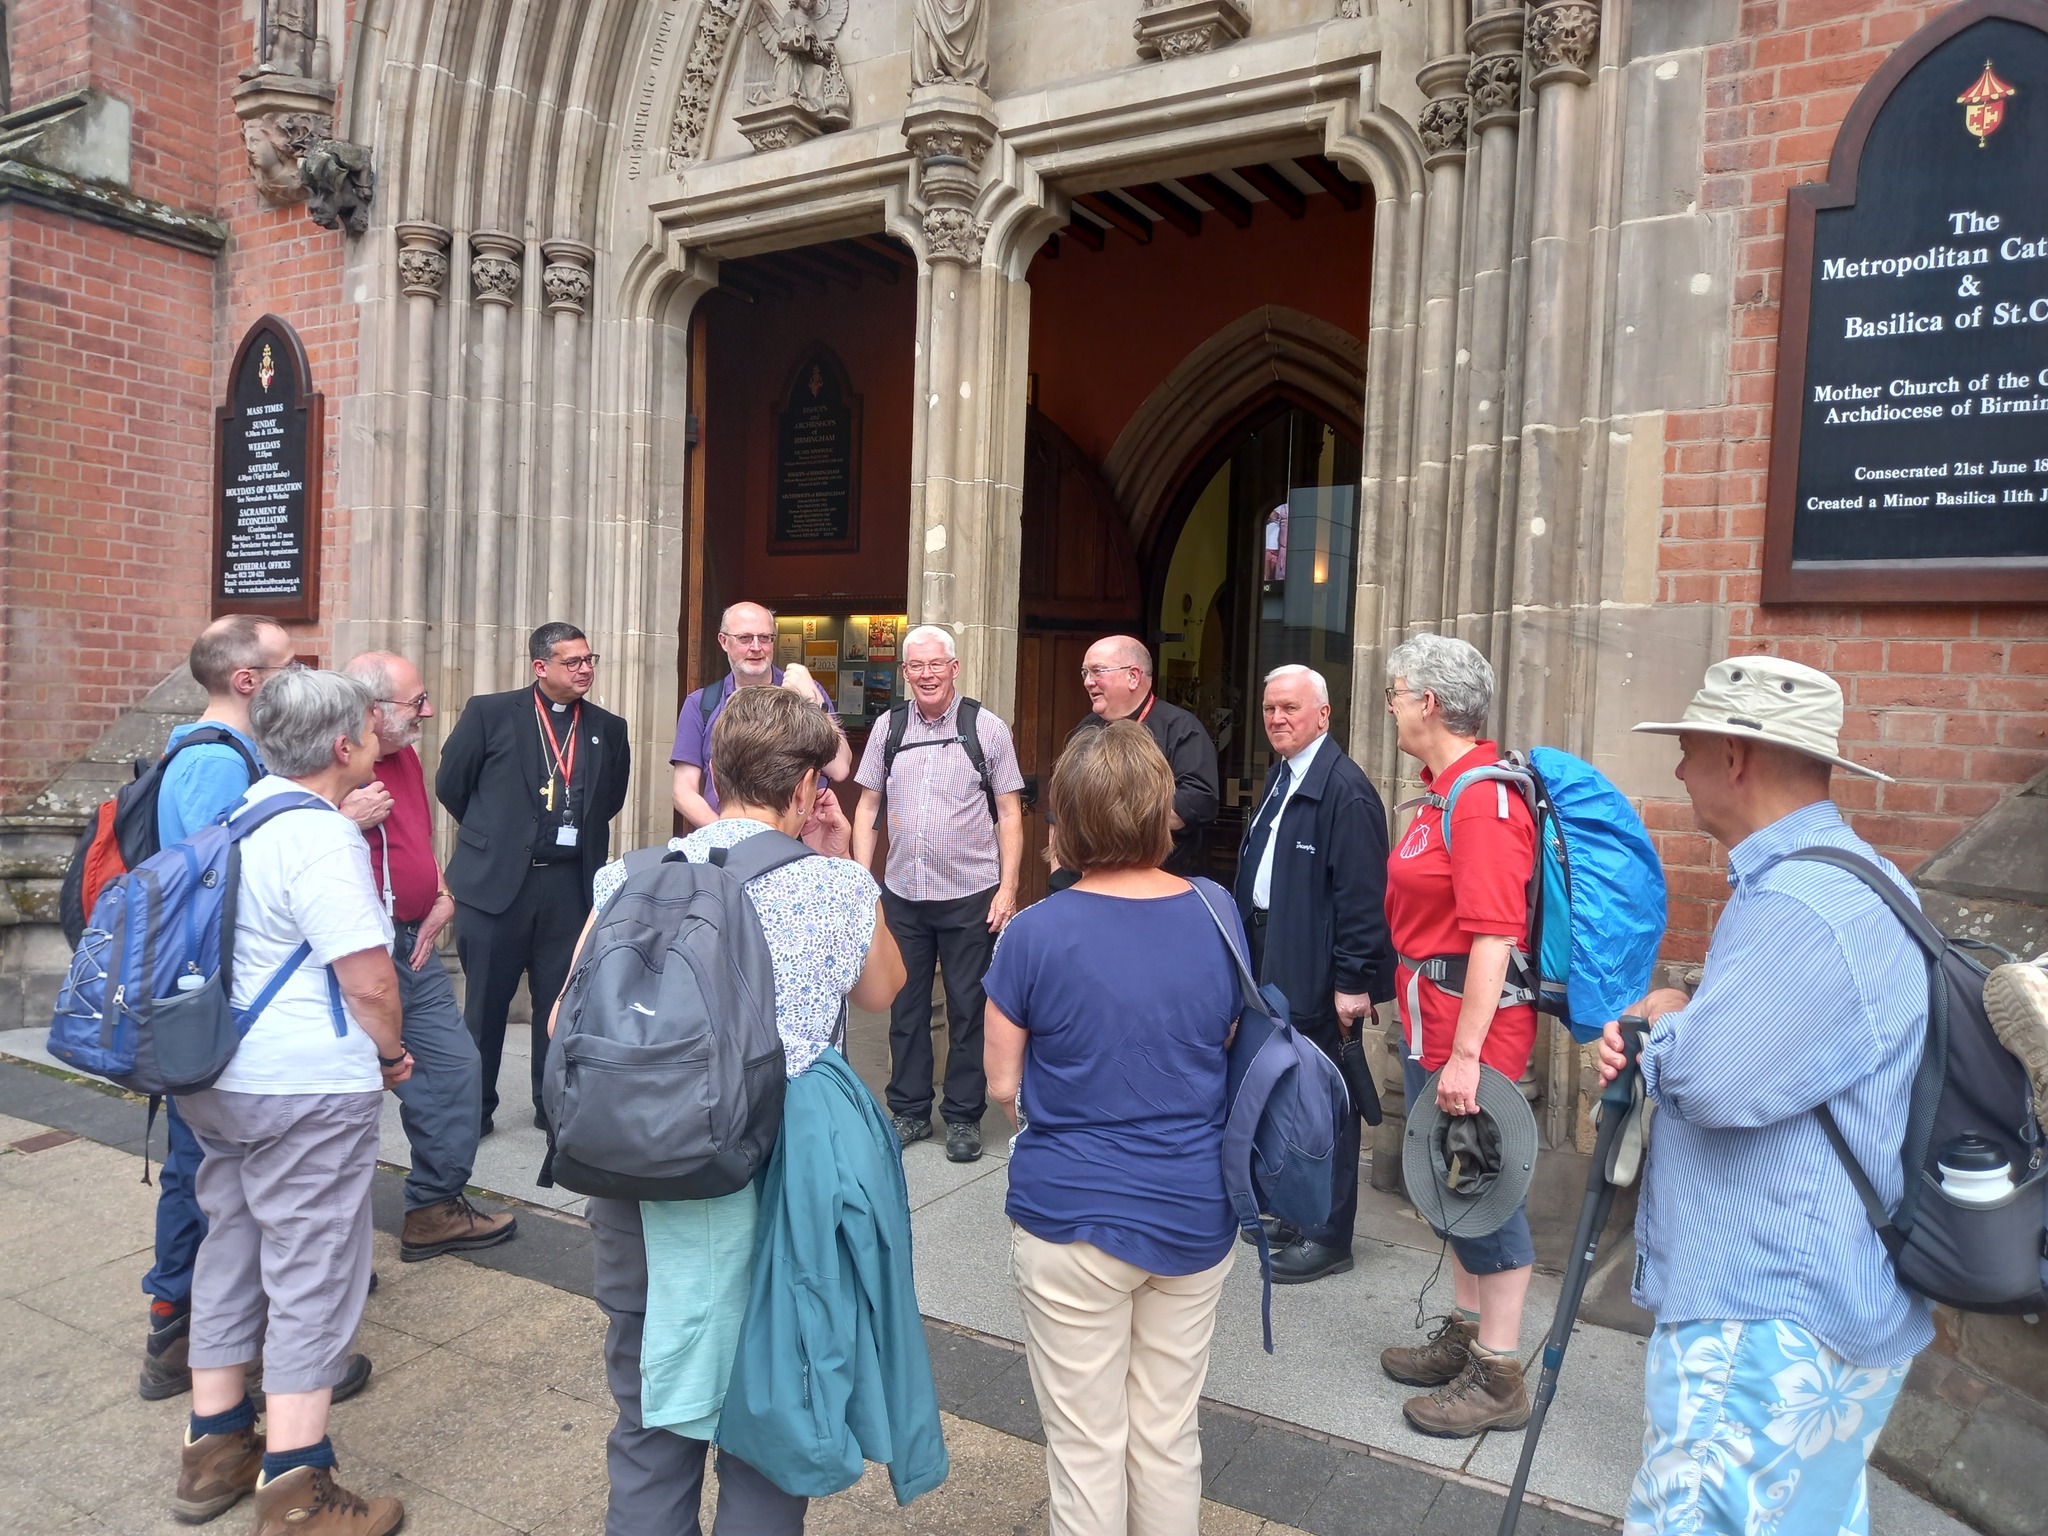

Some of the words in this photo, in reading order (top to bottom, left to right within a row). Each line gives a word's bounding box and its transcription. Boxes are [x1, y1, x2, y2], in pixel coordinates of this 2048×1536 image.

[1948, 211, 2000, 235] The
[1821, 246, 1988, 281] Metropolitan
[1958, 274, 1981, 297] &
[1844, 312, 1943, 339] Basilica
[1955, 306, 1982, 328] of
[1814, 384, 1882, 402] Mother
[1890, 376, 1960, 397] Church
[1968, 374, 1989, 391] of
[1998, 372, 2030, 388] the
[246, 406, 263, 416] MASS
[264, 403, 284, 413] TIMES
[1824, 404, 1943, 424] Archdiocese
[1951, 399, 1972, 416] of
[252, 419, 276, 429] SUNDAY
[248, 440, 280, 451] WEEKDAYS
[794, 434, 834, 444] BIRMINGHAM
[248, 462, 279, 473] SATURDAY
[1854, 464, 1948, 480] Consecrated
[1954, 462, 1984, 476] 21st
[1990, 460, 2027, 475] June
[226, 486, 255, 496] HOLYDAYS
[265, 482, 302, 493] OBLIGATION
[1807, 496, 1863, 510] Created
[1869, 499, 1876, 508] a
[1883, 494, 1929, 507] Minor
[1936, 492, 1996, 506] Basilica
[2002, 489, 2033, 503] 11th
[239, 507, 277, 517] SACRAMENT
[278, 506, 286, 514] OF
[233, 562, 267, 571] CATHEDRAL
[268, 561, 291, 569] OFFICES
[818, 662, 835, 670] 2025
